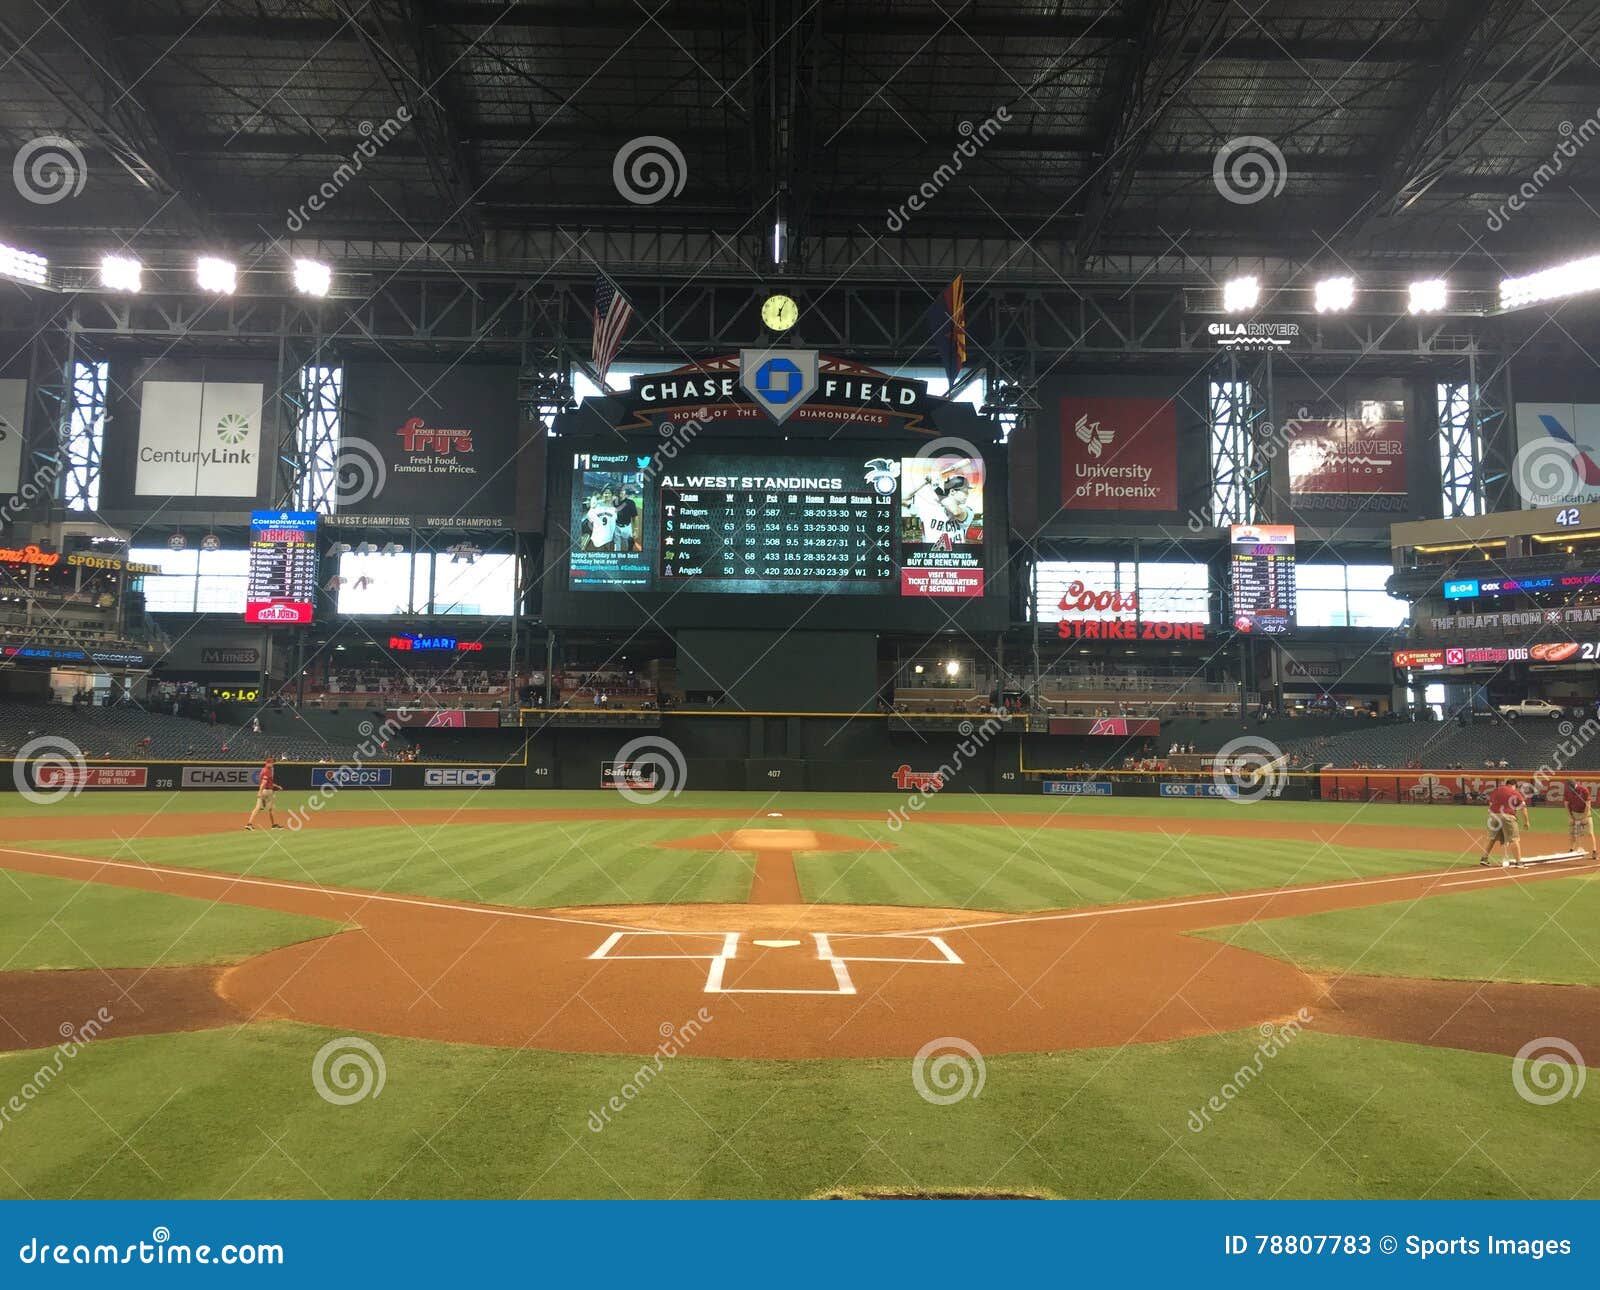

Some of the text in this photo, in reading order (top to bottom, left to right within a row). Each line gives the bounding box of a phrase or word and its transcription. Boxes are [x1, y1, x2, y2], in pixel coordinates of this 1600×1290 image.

[641, 378, 916, 405] CHASE FIELD
[674, 410, 704, 419] HOME
[737, 409, 758, 417] THE
[800, 410, 883, 423] DIAMONDBACKS
[140, 447, 251, 466] CenturyLink
[410, 456, 458, 465] Fresh Food.
[394, 465, 477, 474] Famous Low Prices.
[1076, 463, 1152, 481] University
[661, 476, 842, 489] AL WEST STANDINGS
[1076, 482, 1157, 497] of Phoenix
[680, 508, 708, 516] Rangers
[1556, 508, 1580, 526] 42
[324, 516, 410, 525] NL WEST CHAMPIONS
[427, 518, 502, 527] WORLD CHAMPIONS
[679, 552, 690, 560] A's
[67, 555, 121, 570] SPORTS
[679, 567, 702, 575] Angels
[931, 578, 978, 586] HEADQUARTERS
[1058, 580, 1138, 612] Coors
[1457, 614, 1499, 629] DRAFT
[1503, 611, 1541, 626] ROOM
[1058, 620, 1205, 640] STRIKE ZONE
[1508, 648, 1528, 660] DOG
[190, 770, 248, 783] CHASE
[340, 769, 381, 785] pepsi
[535, 767, 548, 775] 413
[604, 768, 642, 776] Safelite
[767, 770, 780, 778] 407
[1001, 771, 1015, 780] 413
[426, 770, 495, 785] GEICO
[1165, 785, 1232, 795] COX COX
